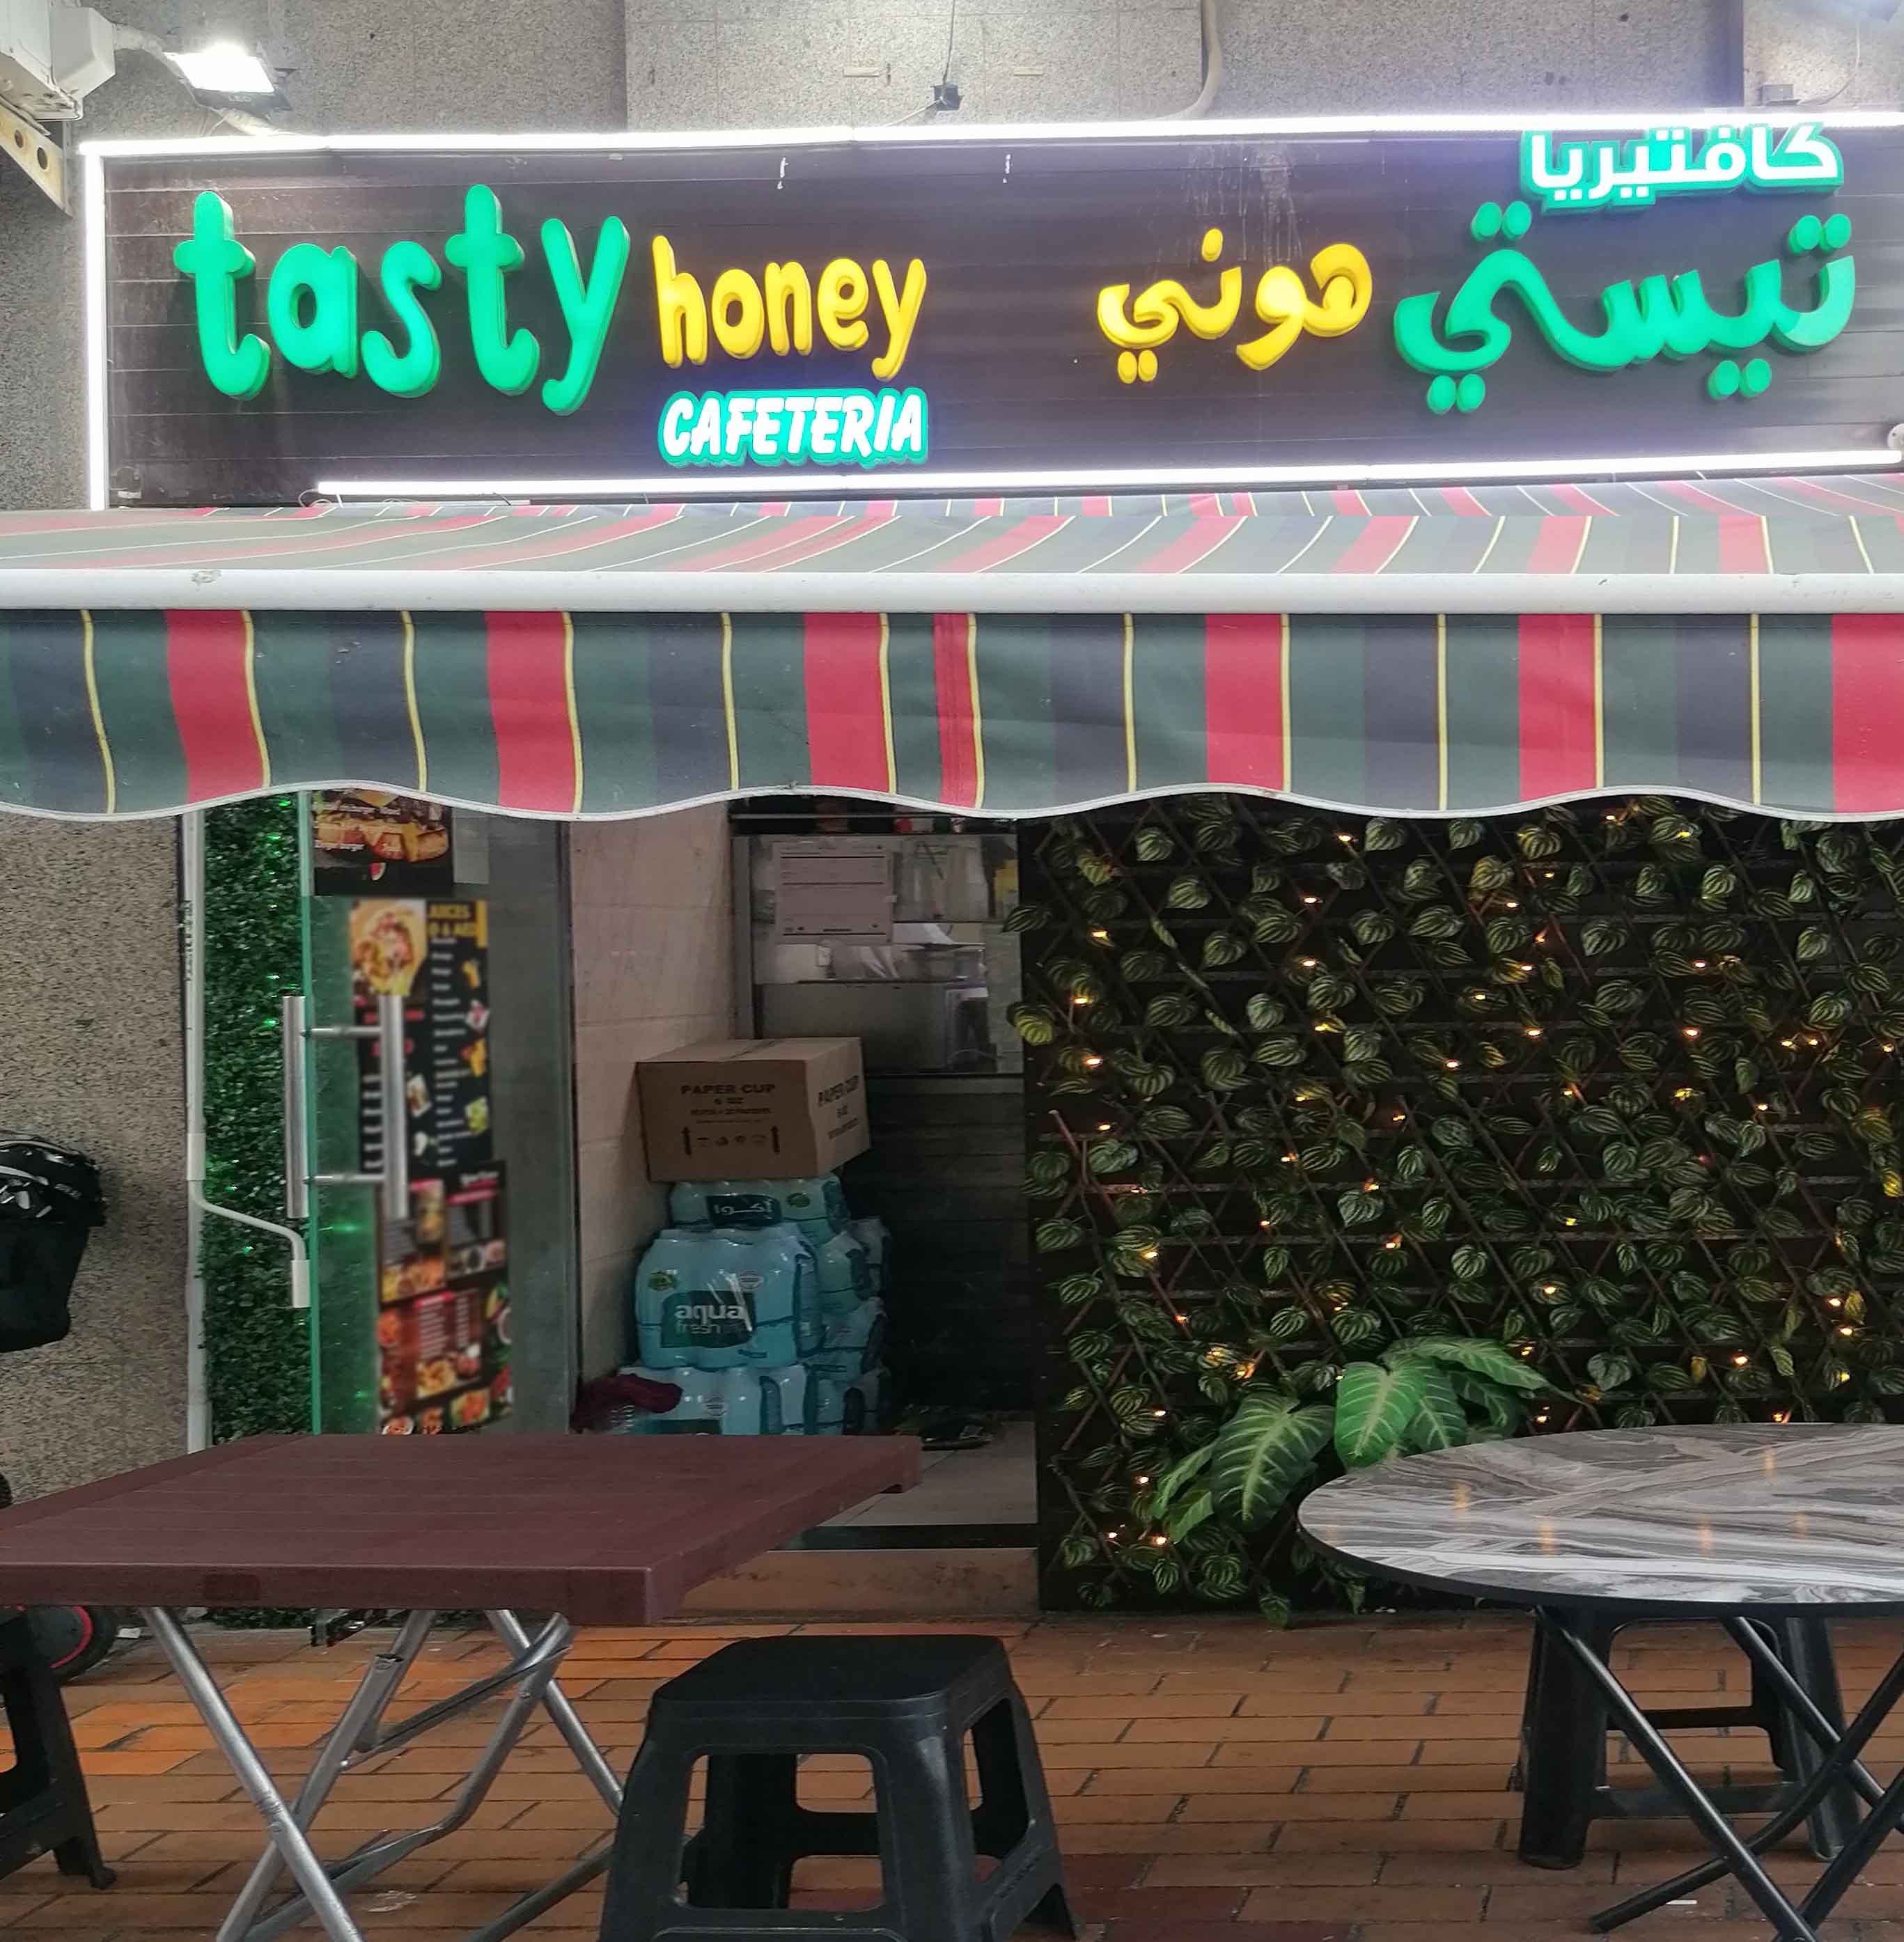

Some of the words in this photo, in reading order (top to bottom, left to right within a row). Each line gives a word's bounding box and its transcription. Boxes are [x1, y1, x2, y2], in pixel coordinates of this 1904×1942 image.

[1531, 123, 1839, 201] كافتيريا
[173, 185, 631, 416] tasty
[651, 234, 928, 383] honey
[1095, 228, 1374, 384] هوني
[1393, 200, 1856, 414] تيستي
[662, 393, 925, 460] CAFETERIA
[680, 1083, 736, 1095] PAPER
[740, 1083, 776, 1094] CUP
[674, 1303, 744, 1324] aqua
